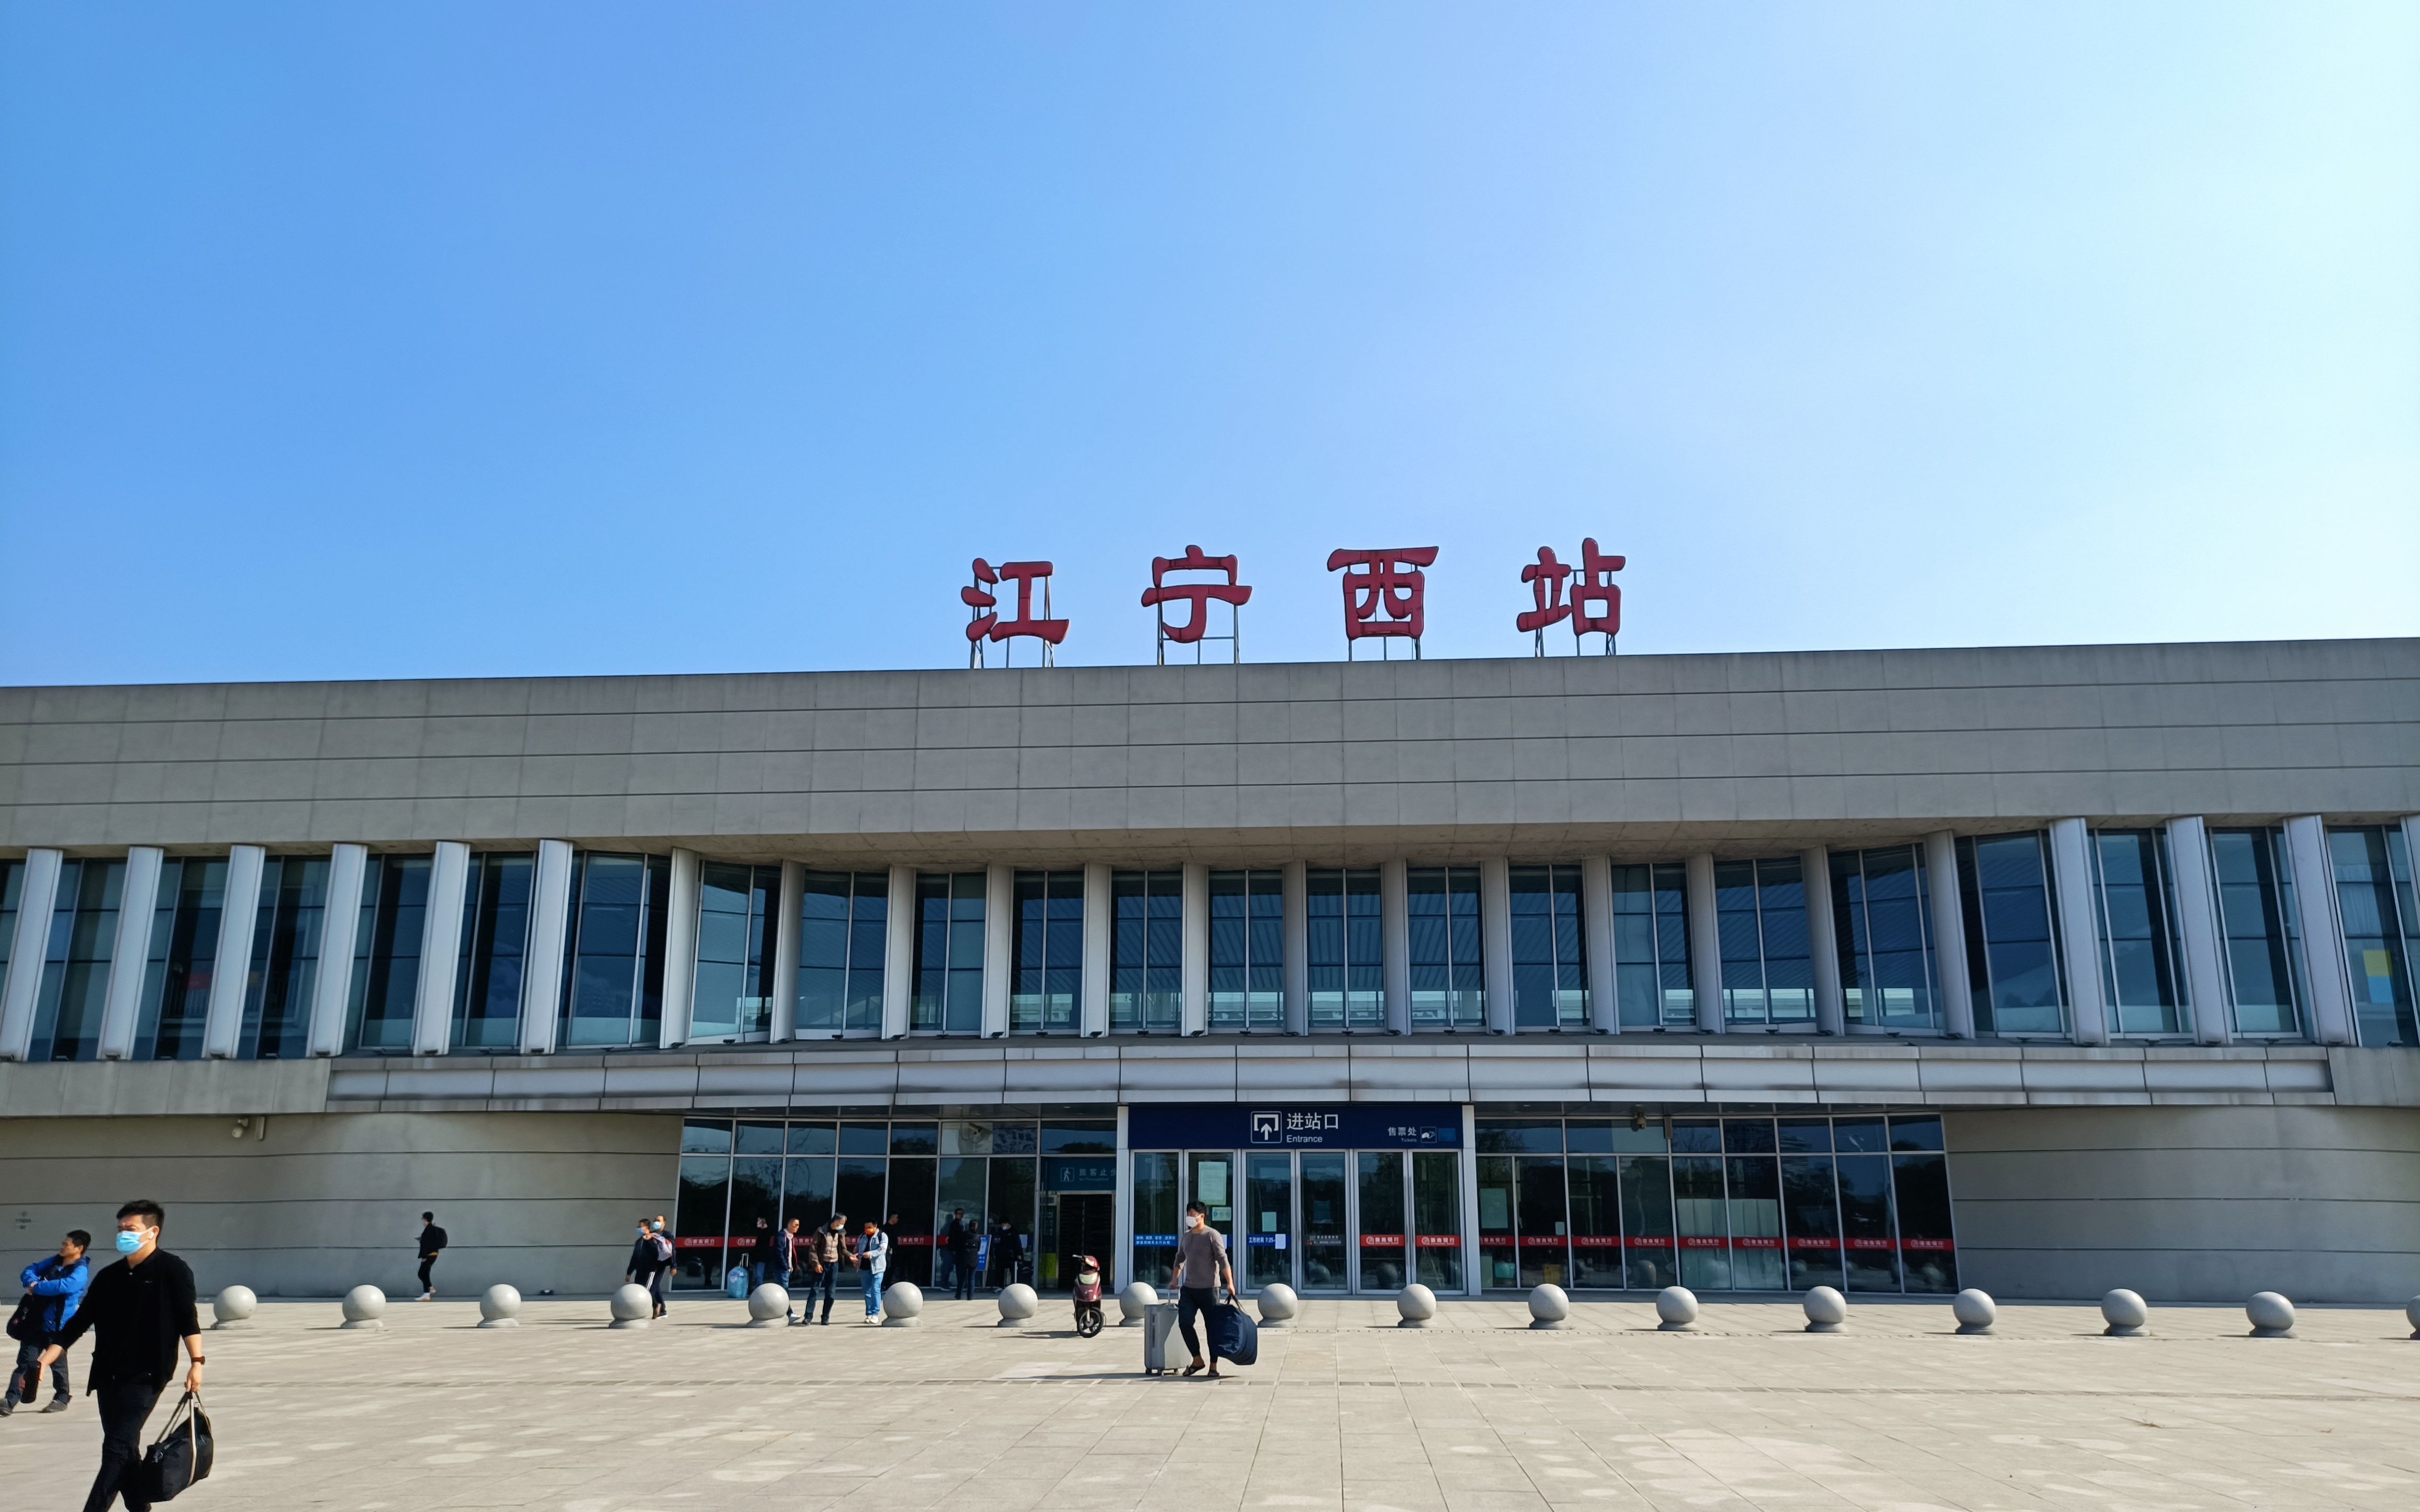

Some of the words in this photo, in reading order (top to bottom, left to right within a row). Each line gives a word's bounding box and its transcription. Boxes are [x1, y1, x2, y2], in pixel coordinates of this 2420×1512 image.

[961, 537, 1626, 644] 江宁西站
[1286, 1112, 1339, 1130] 进站口
[1388, 1126, 1417, 1136] 售票处
